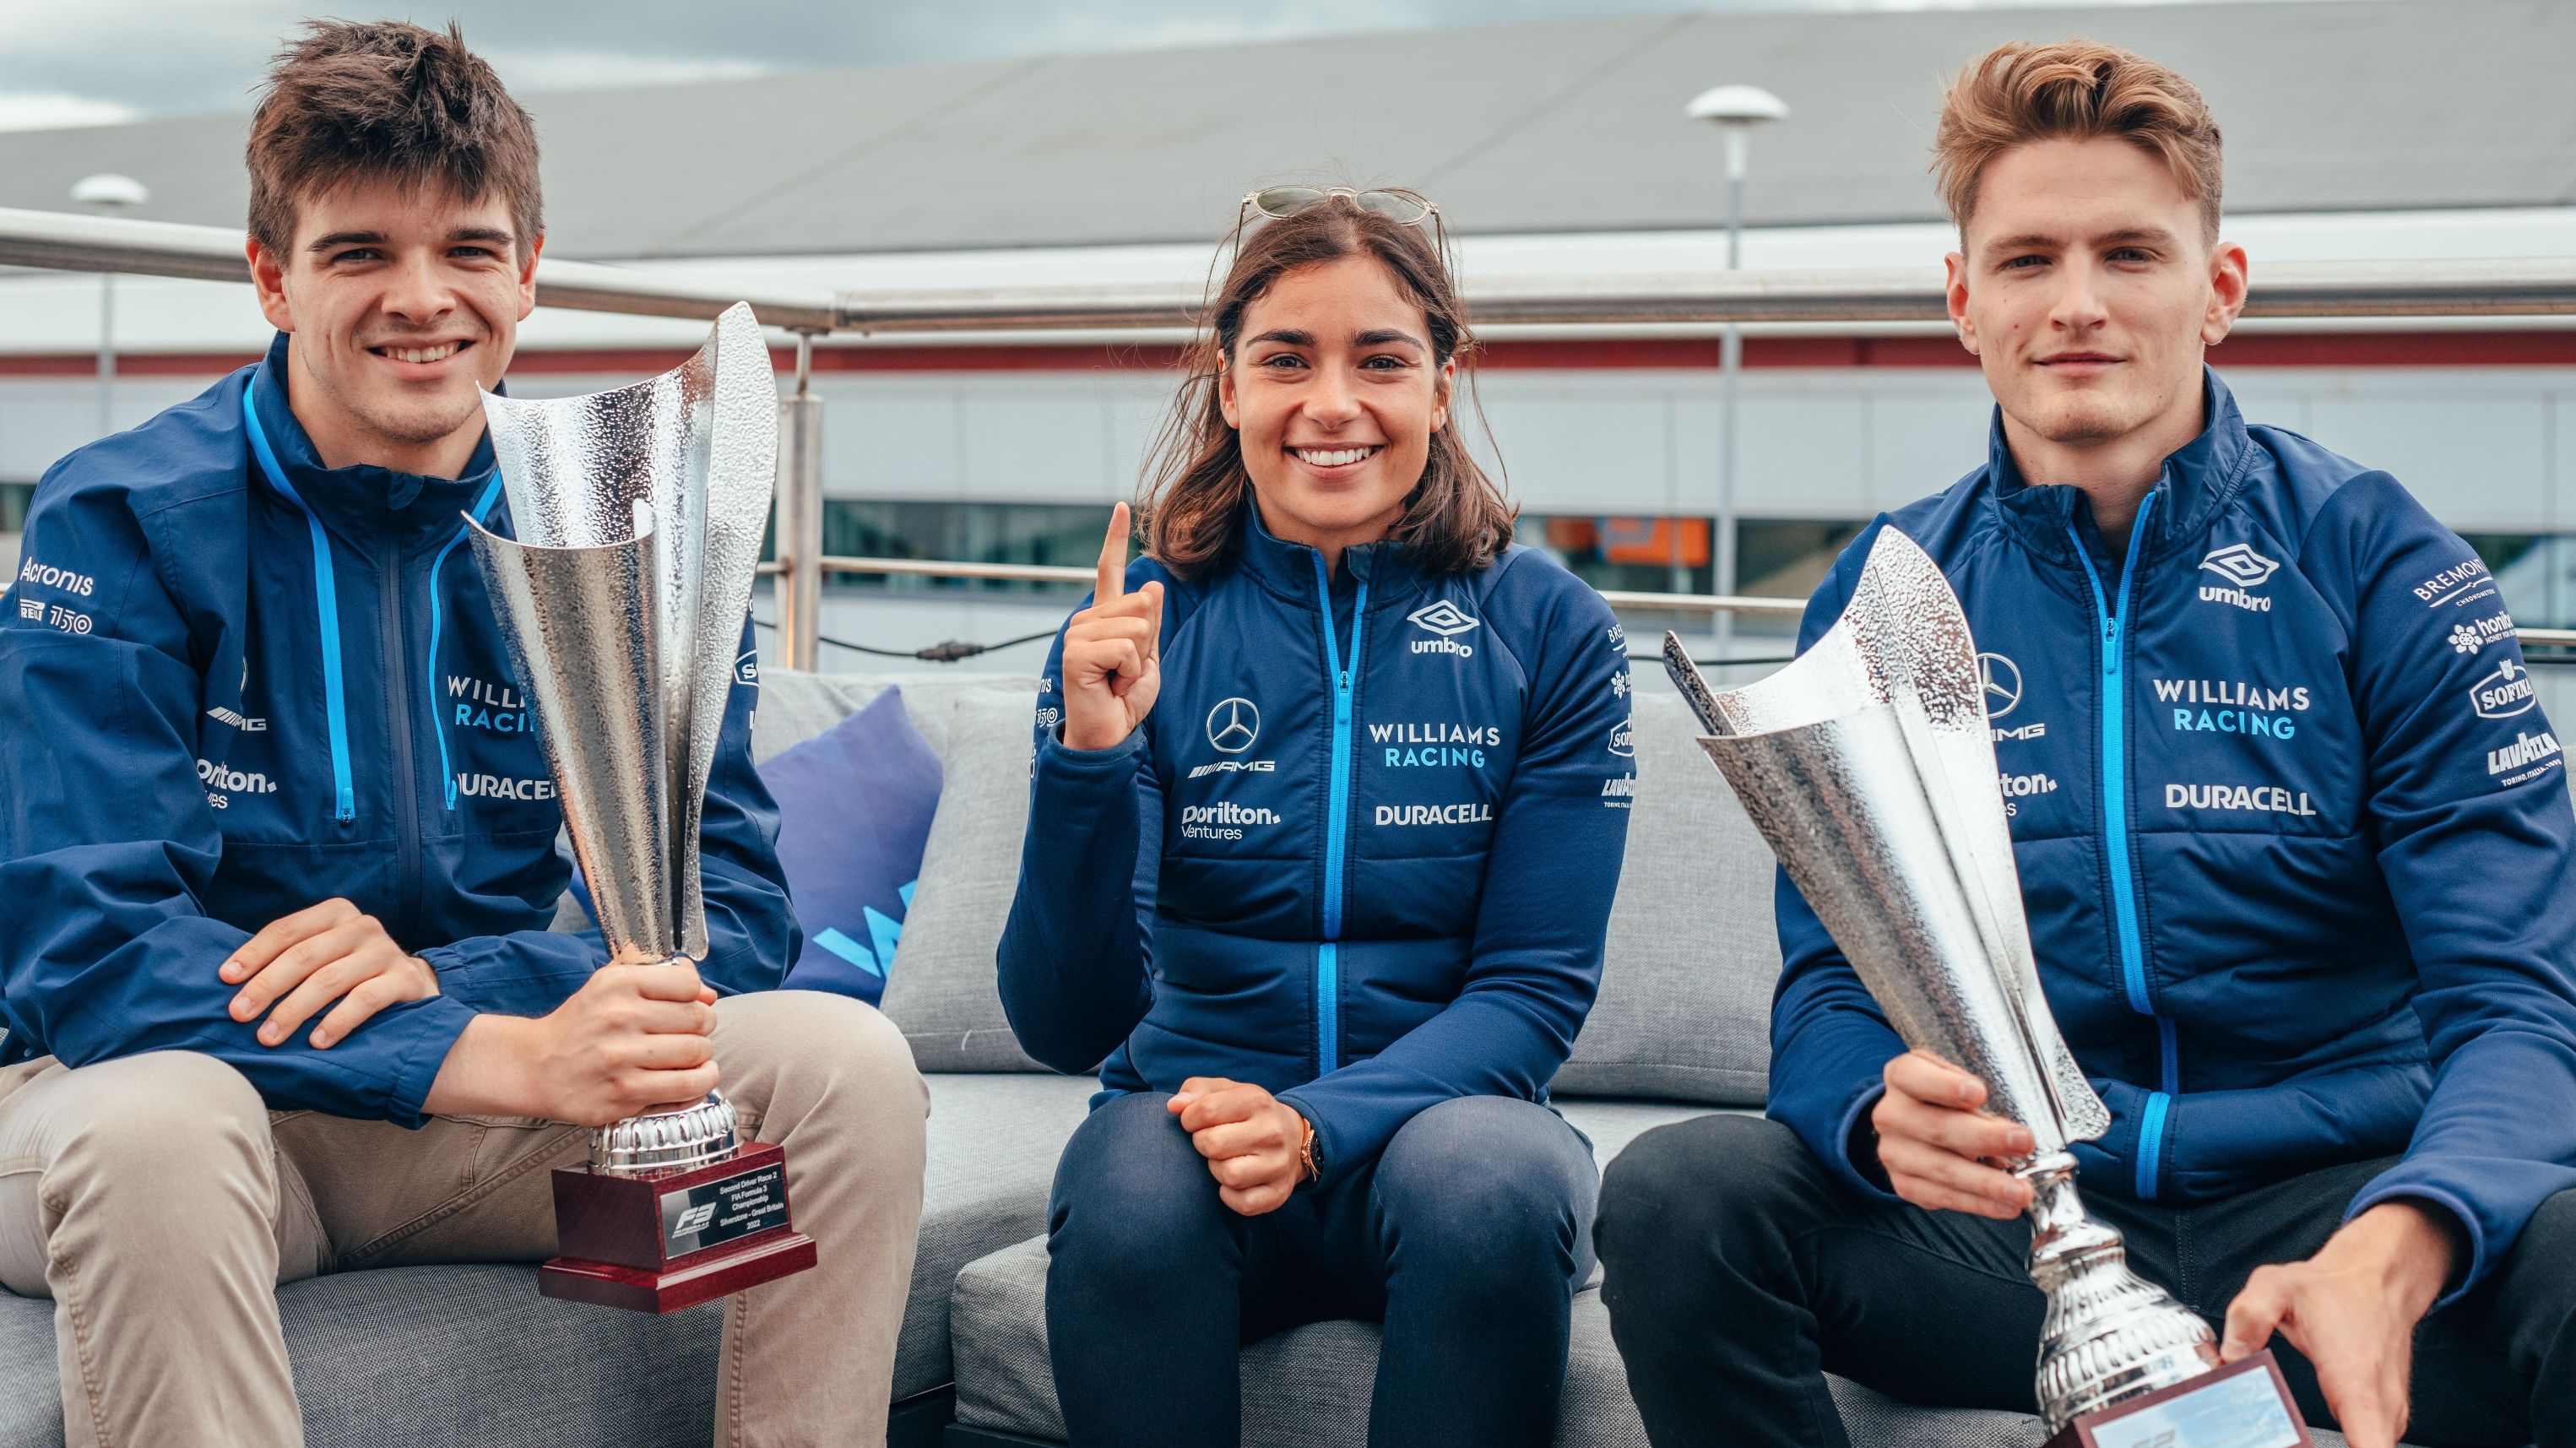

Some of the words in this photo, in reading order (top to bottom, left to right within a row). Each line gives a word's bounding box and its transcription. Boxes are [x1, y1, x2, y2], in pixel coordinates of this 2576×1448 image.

[19, 556, 94, 596] Acronis
[2199, 587, 2271, 612] umbro
[1411, 637, 1472, 658] umbro
[2153, 679, 2310, 711] WILLIAMS
[455, 703, 534, 733] RACI
[2173, 708, 2295, 740] RACING
[1369, 724, 1500, 746] WILLIAMS
[1385, 747, 1485, 768] RACING
[2487, 732, 2562, 775] LAVAZZA
[2166, 784, 2316, 816] DURACELL
[1375, 804, 1494, 826] DURACELL
[1181, 824, 1243, 840] Ventures
[719, 1182, 740, 1195] Second
[740, 1178, 757, 1189] Driver
[757, 1174, 773, 1185] Race
[772, 1171, 778, 1180] 2
[731, 1193, 741, 1202] FIA
[741, 1187, 763, 1198] Formula
[719, 1212, 749, 1227] Silverstone
[751, 1207, 766, 1218] Great
[766, 1201, 784, 1212] Britain
[731, 1194, 769, 1211] Championship
[675, 1201, 717, 1230] F3
[746, 1219, 761, 1230] 2022
